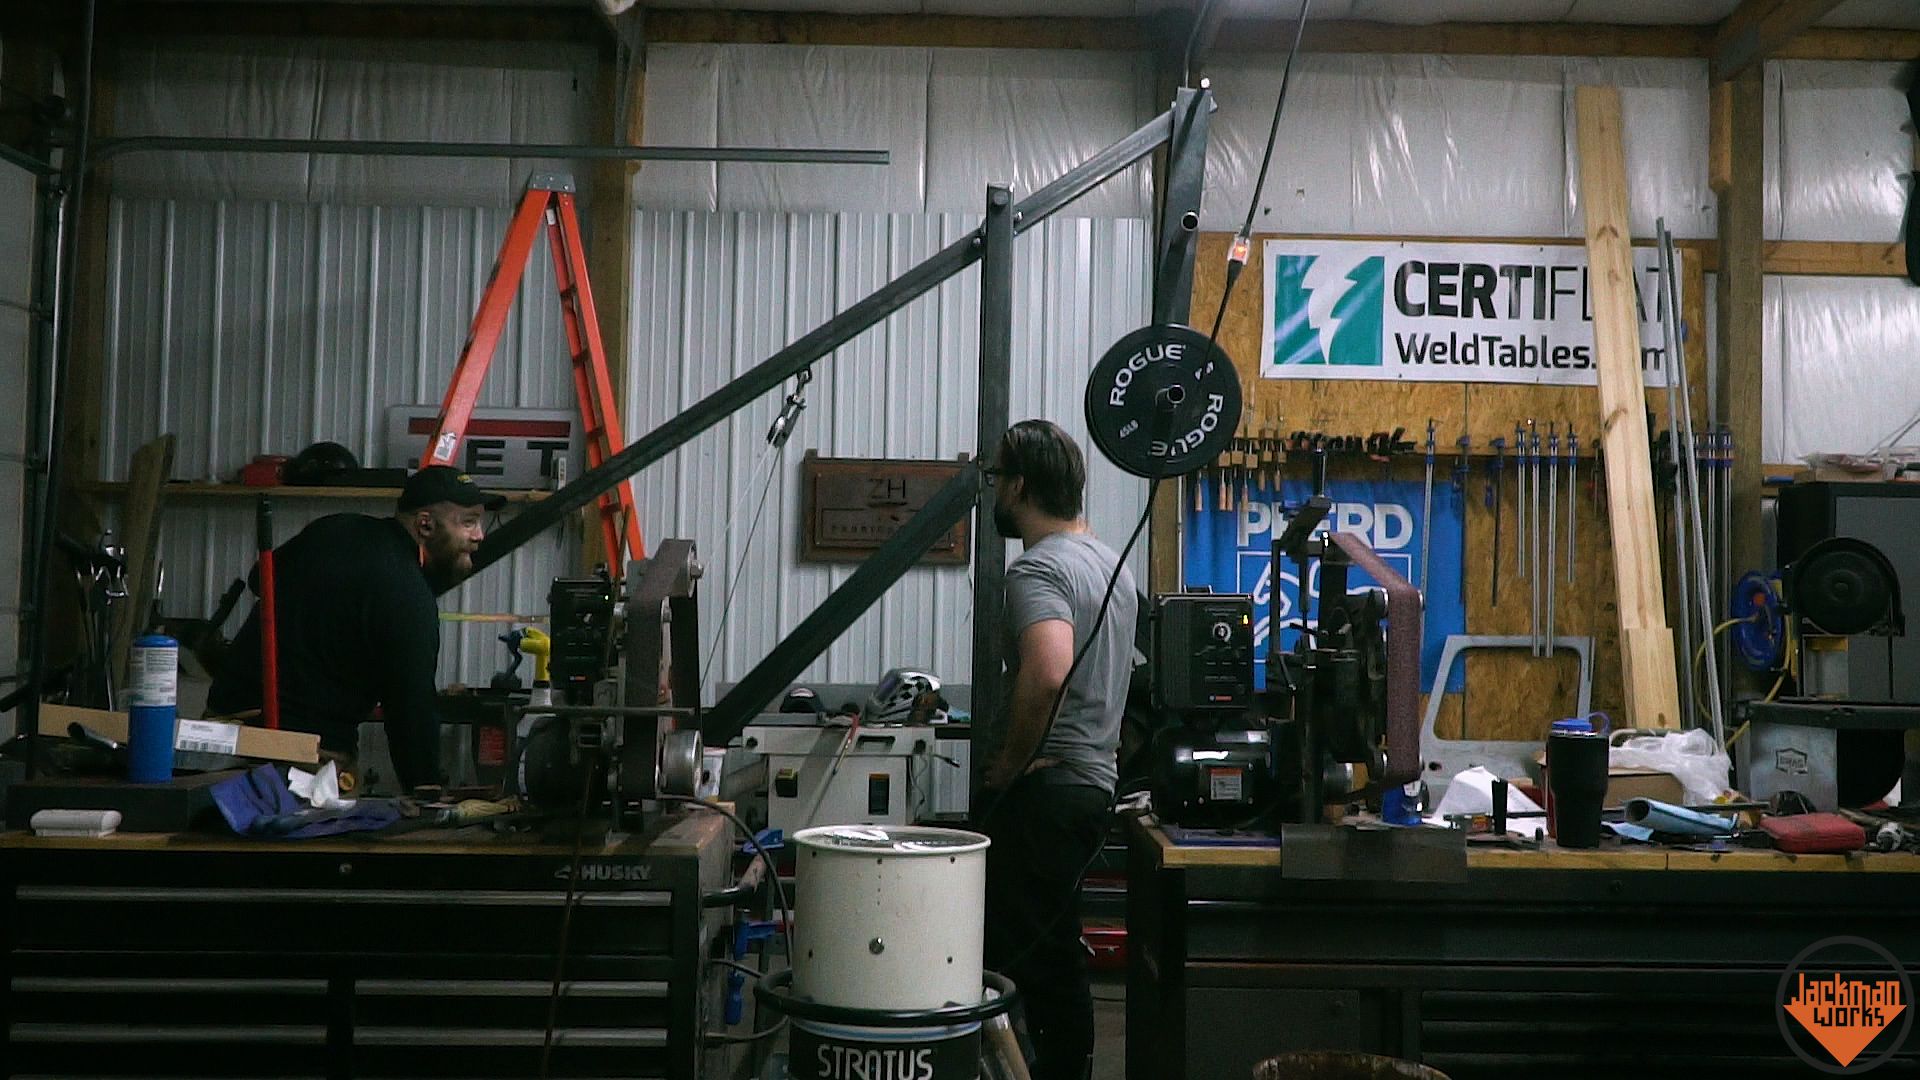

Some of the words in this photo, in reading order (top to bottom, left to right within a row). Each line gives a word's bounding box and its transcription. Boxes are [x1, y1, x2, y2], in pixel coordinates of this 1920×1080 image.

[1394, 332, 1666, 371] WeldTables.m
[1109, 344, 1183, 406] ROGUE
[408, 439, 570, 478] ET
[1237, 502, 1413, 550] PRD
[581, 864, 652, 880] HUSKY
[816, 1044, 934, 1080] STRATUS
